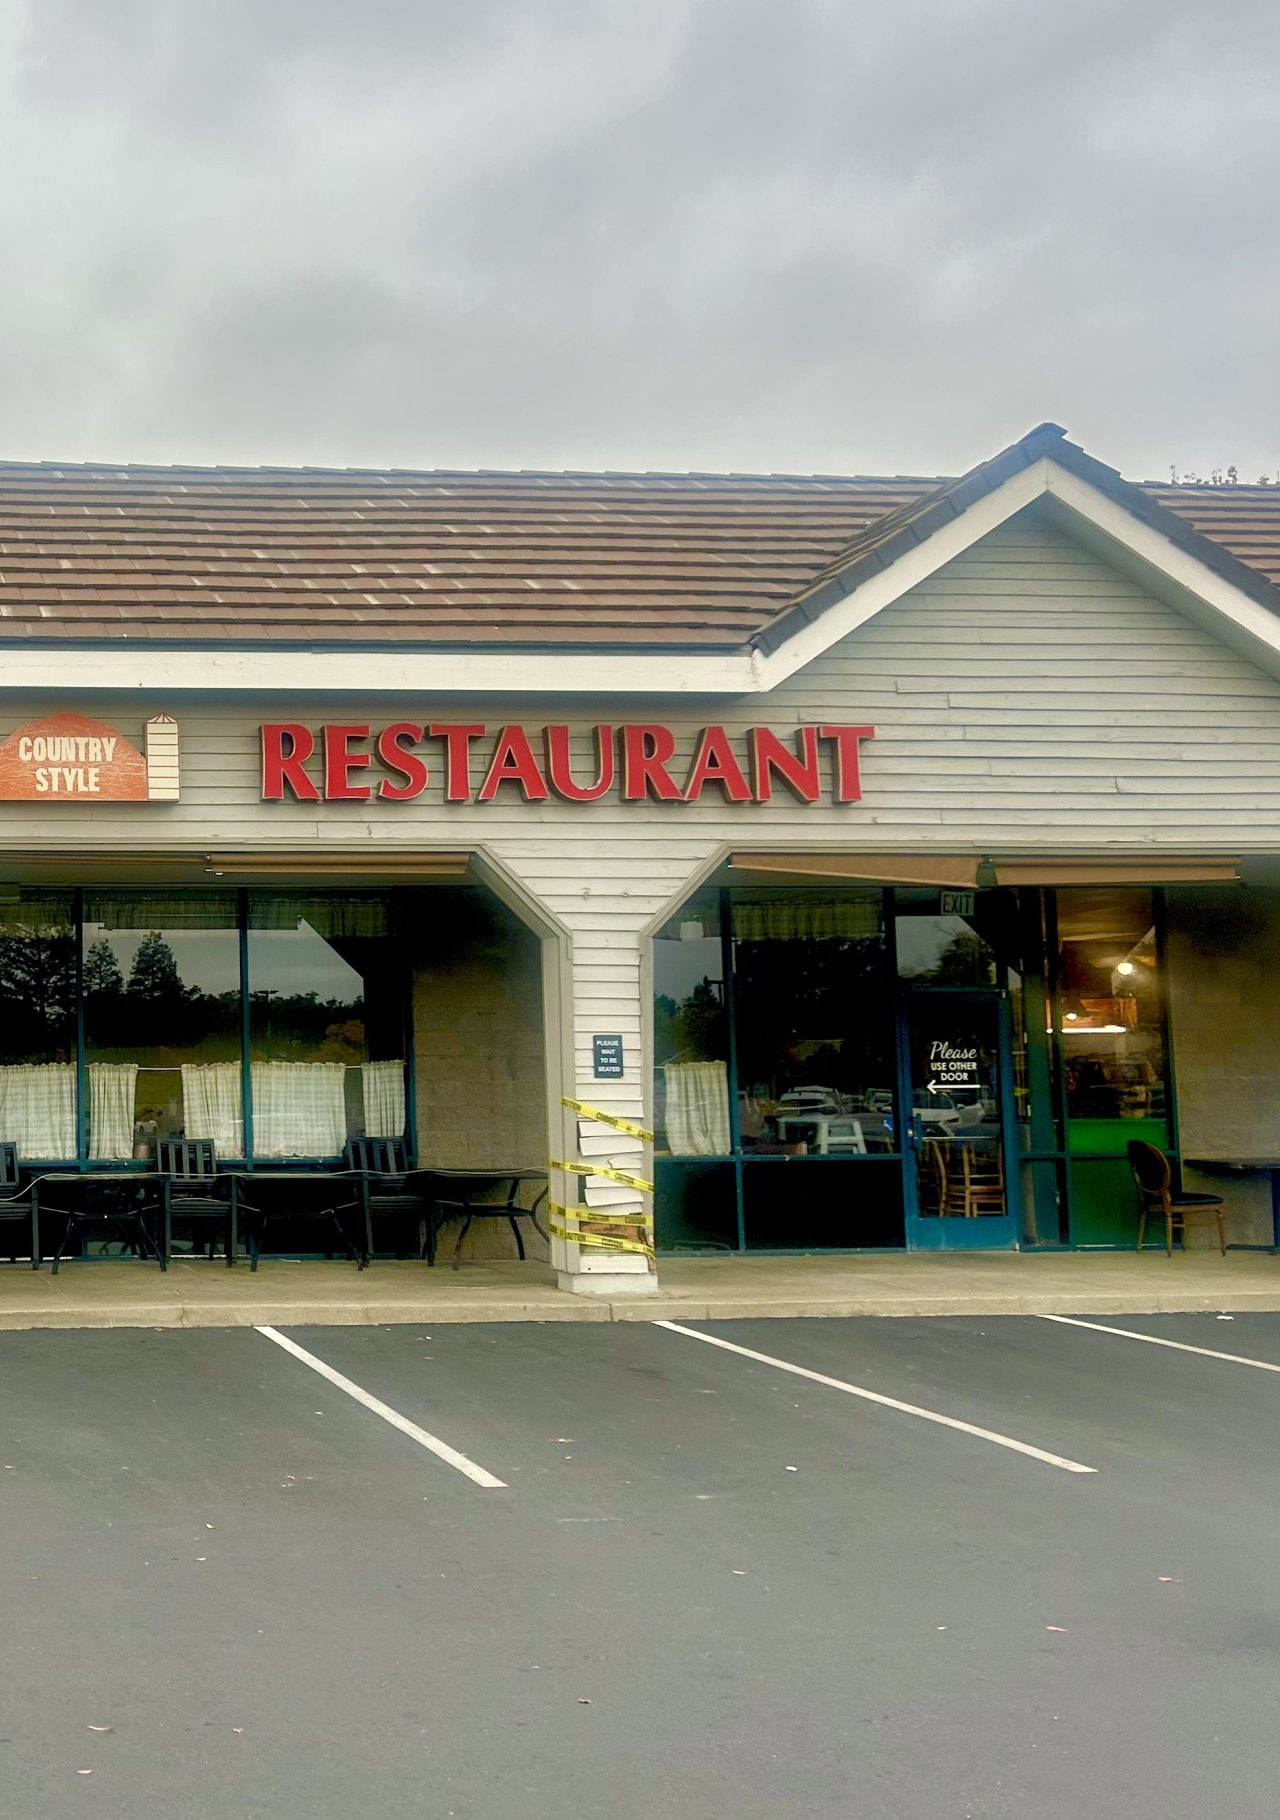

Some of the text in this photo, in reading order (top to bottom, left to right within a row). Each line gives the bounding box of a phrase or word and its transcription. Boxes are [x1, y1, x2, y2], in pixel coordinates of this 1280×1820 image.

[18, 736, 117, 763] COUNTRY
[259, 722, 876, 802] RESTAURANT
[35, 767, 100, 793] STYLE
[943, 894, 973, 913] EXIT
[930, 1041, 978, 1060] Please
[930, 1062, 978, 1071] USE OTHER
[940, 1072, 969, 1081] DOOR
